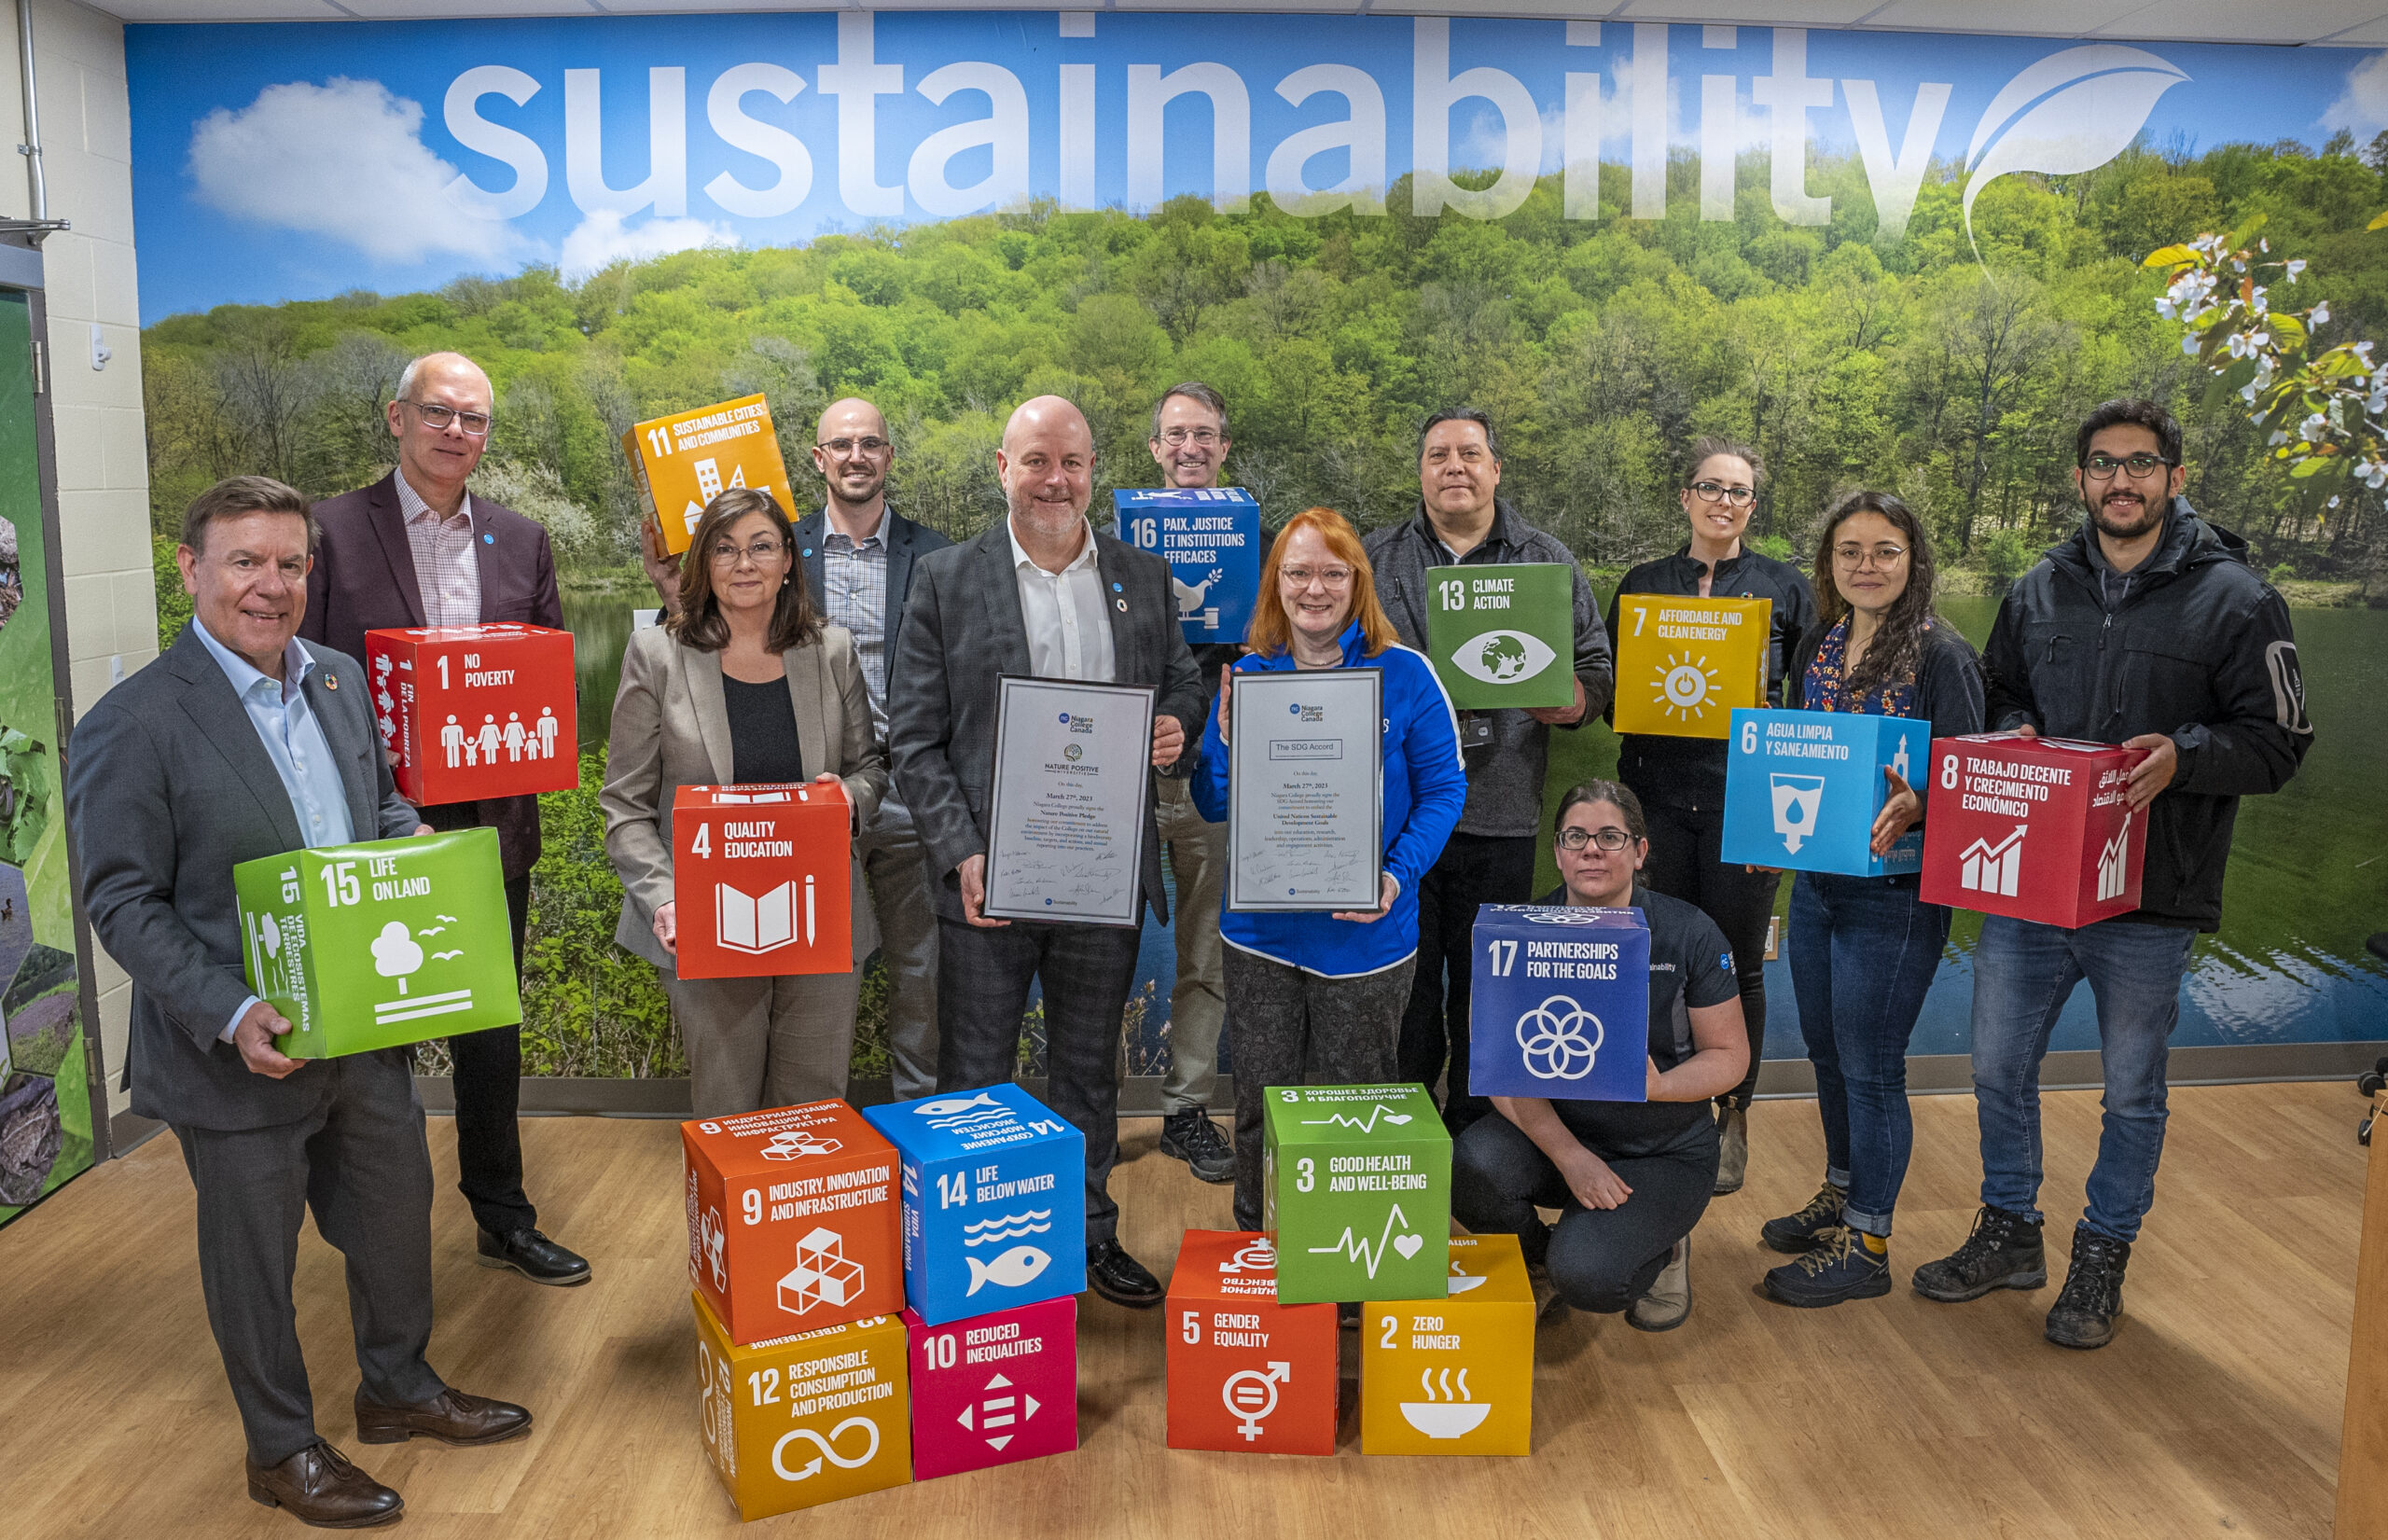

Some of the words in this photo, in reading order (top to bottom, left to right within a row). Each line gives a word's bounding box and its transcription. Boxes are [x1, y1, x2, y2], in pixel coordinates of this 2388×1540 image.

[441, 10, 1954, 244] sustainability
[673, 409, 733, 437] SUSTAINABLE
[734, 403, 763, 421] CITIES
[647, 426, 672, 457] 11
[678, 436, 699, 451] AND
[699, 421, 760, 447] COMMUNITIES
[1131, 518, 1157, 548] 16
[1163, 518, 1190, 532] PAIX,
[1192, 517, 1233, 531] JUSTICE
[1163, 534, 1176, 548] ET
[1177, 534, 1245, 548] INSTITUTIONS
[1163, 550, 1216, 563] EFFICACES
[1438, 580, 1465, 611] 13
[1473, 578, 1514, 593] CLIMATE
[1473, 595, 1510, 610] ACTION
[1633, 607, 1646, 636] 7
[1659, 609, 1719, 625] AFFORDABLE
[1721, 612, 1742, 626] AND
[1658, 626, 1688, 639] CLEAN
[1689, 627, 1728, 641] ENERGY
[399, 659, 412, 672] 1
[437, 655, 450, 689] 1
[465, 654, 480, 669] NO
[400, 682, 407, 696] DE
[465, 670, 515, 687] POVERTY
[401, 700, 408, 713] LA
[402, 715, 411, 768] POBREZA
[1742, 721, 1757, 755] 6
[1766, 722, 1795, 738] AGUA
[1797, 724, 1833, 741] LIMPIA
[1766, 741, 1772, 756] Y
[1774, 742, 1849, 760] SANEAMIENTO
[1941, 754, 1959, 790] 8
[1966, 756, 2019, 780] TRABAJO
[2020, 764, 2072, 785] DECENTE
[1965, 775, 1973, 790] Y
[1974, 777, 2048, 802] CRECIMIENTO
[1962, 793, 2029, 818] ECONÓMICO
[691, 823, 712, 859] 4
[724, 821, 775, 839] QUALITY
[725, 840, 793, 859] EDUCATION
[369, 857, 397, 878] LIFE
[281, 866, 300, 904] 15
[320, 862, 361, 908] 15
[373, 882, 394, 901] ON
[395, 877, 431, 899] LAND
[286, 916, 296, 933] DE
[296, 914, 307, 949] VIDA
[280, 917, 300, 1002] TERRESTRES
[1488, 939, 1519, 977] 17
[1527, 941, 1618, 960] PARTNERSHIPS
[1527, 961, 1550, 978] FOR
[1551, 962, 1576, 979] THE
[1576, 963, 1617, 980] GOALS
[1649, 963, 1676, 972] ainability
[289, 936, 310, 1032] ECOSISTEMAS
[1281, 1089, 1299, 1103] 3
[1318, 1093, 1408, 1103] БЛАГОПОЛУЧИЕ
[1359, 1087, 1419, 1095] ЗДОРОВЬЕ
[700, 1121, 722, 1135] 9
[728, 1116, 802, 1132] ИННОВАЦИИ
[732, 1117, 838, 1138] ИНФРАСТРУКТУРА
[952, 1118, 1018, 1134] ЭКОСИСТЕМ
[970, 1125, 1026, 1140] МОРСКИХ
[1028, 1119, 1064, 1135] 14
[961, 1131, 1034, 1150] СОХРАНЕНИЕ
[976, 1165, 998, 1184] LIFE
[1329, 1157, 1365, 1172] GOOD
[1366, 1155, 1411, 1172] HEALTH
[770, 1178, 826, 1202] INDUSTRY,
[826, 1165, 890, 1192] INNOVATION
[902, 1163, 918, 1198] 14
[1297, 1158, 1315, 1193] 3
[1329, 1176, 1355, 1192] AND
[1357, 1173, 1427, 1191] WELL-BEING
[937, 1172, 968, 1209] 14
[977, 1182, 1016, 1203] BELOW
[1017, 1173, 1055, 1195] WATER
[742, 1188, 762, 1226] 9
[771, 1203, 795, 1222] AND
[796, 1185, 888, 1218] INFRASTRUCTURE
[911, 1210, 920, 1238] VIDA
[903, 1201, 912, 1271] SUBMARINA
[1220, 1286, 1278, 1296] НДЕРНОЕ
[1222, 1277, 1278, 1286] ВЕНСТВО
[1183, 1311, 1201, 1344] 5
[1214, 1312, 1259, 1329] GENDER
[1381, 1315, 1398, 1349] 2
[1412, 1316, 1444, 1332] ZERO
[751, 1325, 847, 1350] ОТВЕТСТВЕННОЕ
[966, 1323, 1020, 1346] REDUCED
[1214, 1331, 1269, 1348] EQUALITY
[1411, 1335, 1460, 1350] HUNGER
[923, 1334, 956, 1370] 10
[966, 1337, 1042, 1365] INEQUALITIES
[718, 1357, 730, 1394] 12
[789, 1350, 868, 1380] RESPONSIBLE
[748, 1367, 781, 1406] 12
[789, 1367, 875, 1399] CONSUMPTION
[791, 1398, 817, 1418] AND
[818, 1381, 893, 1412] PRODUCTION
